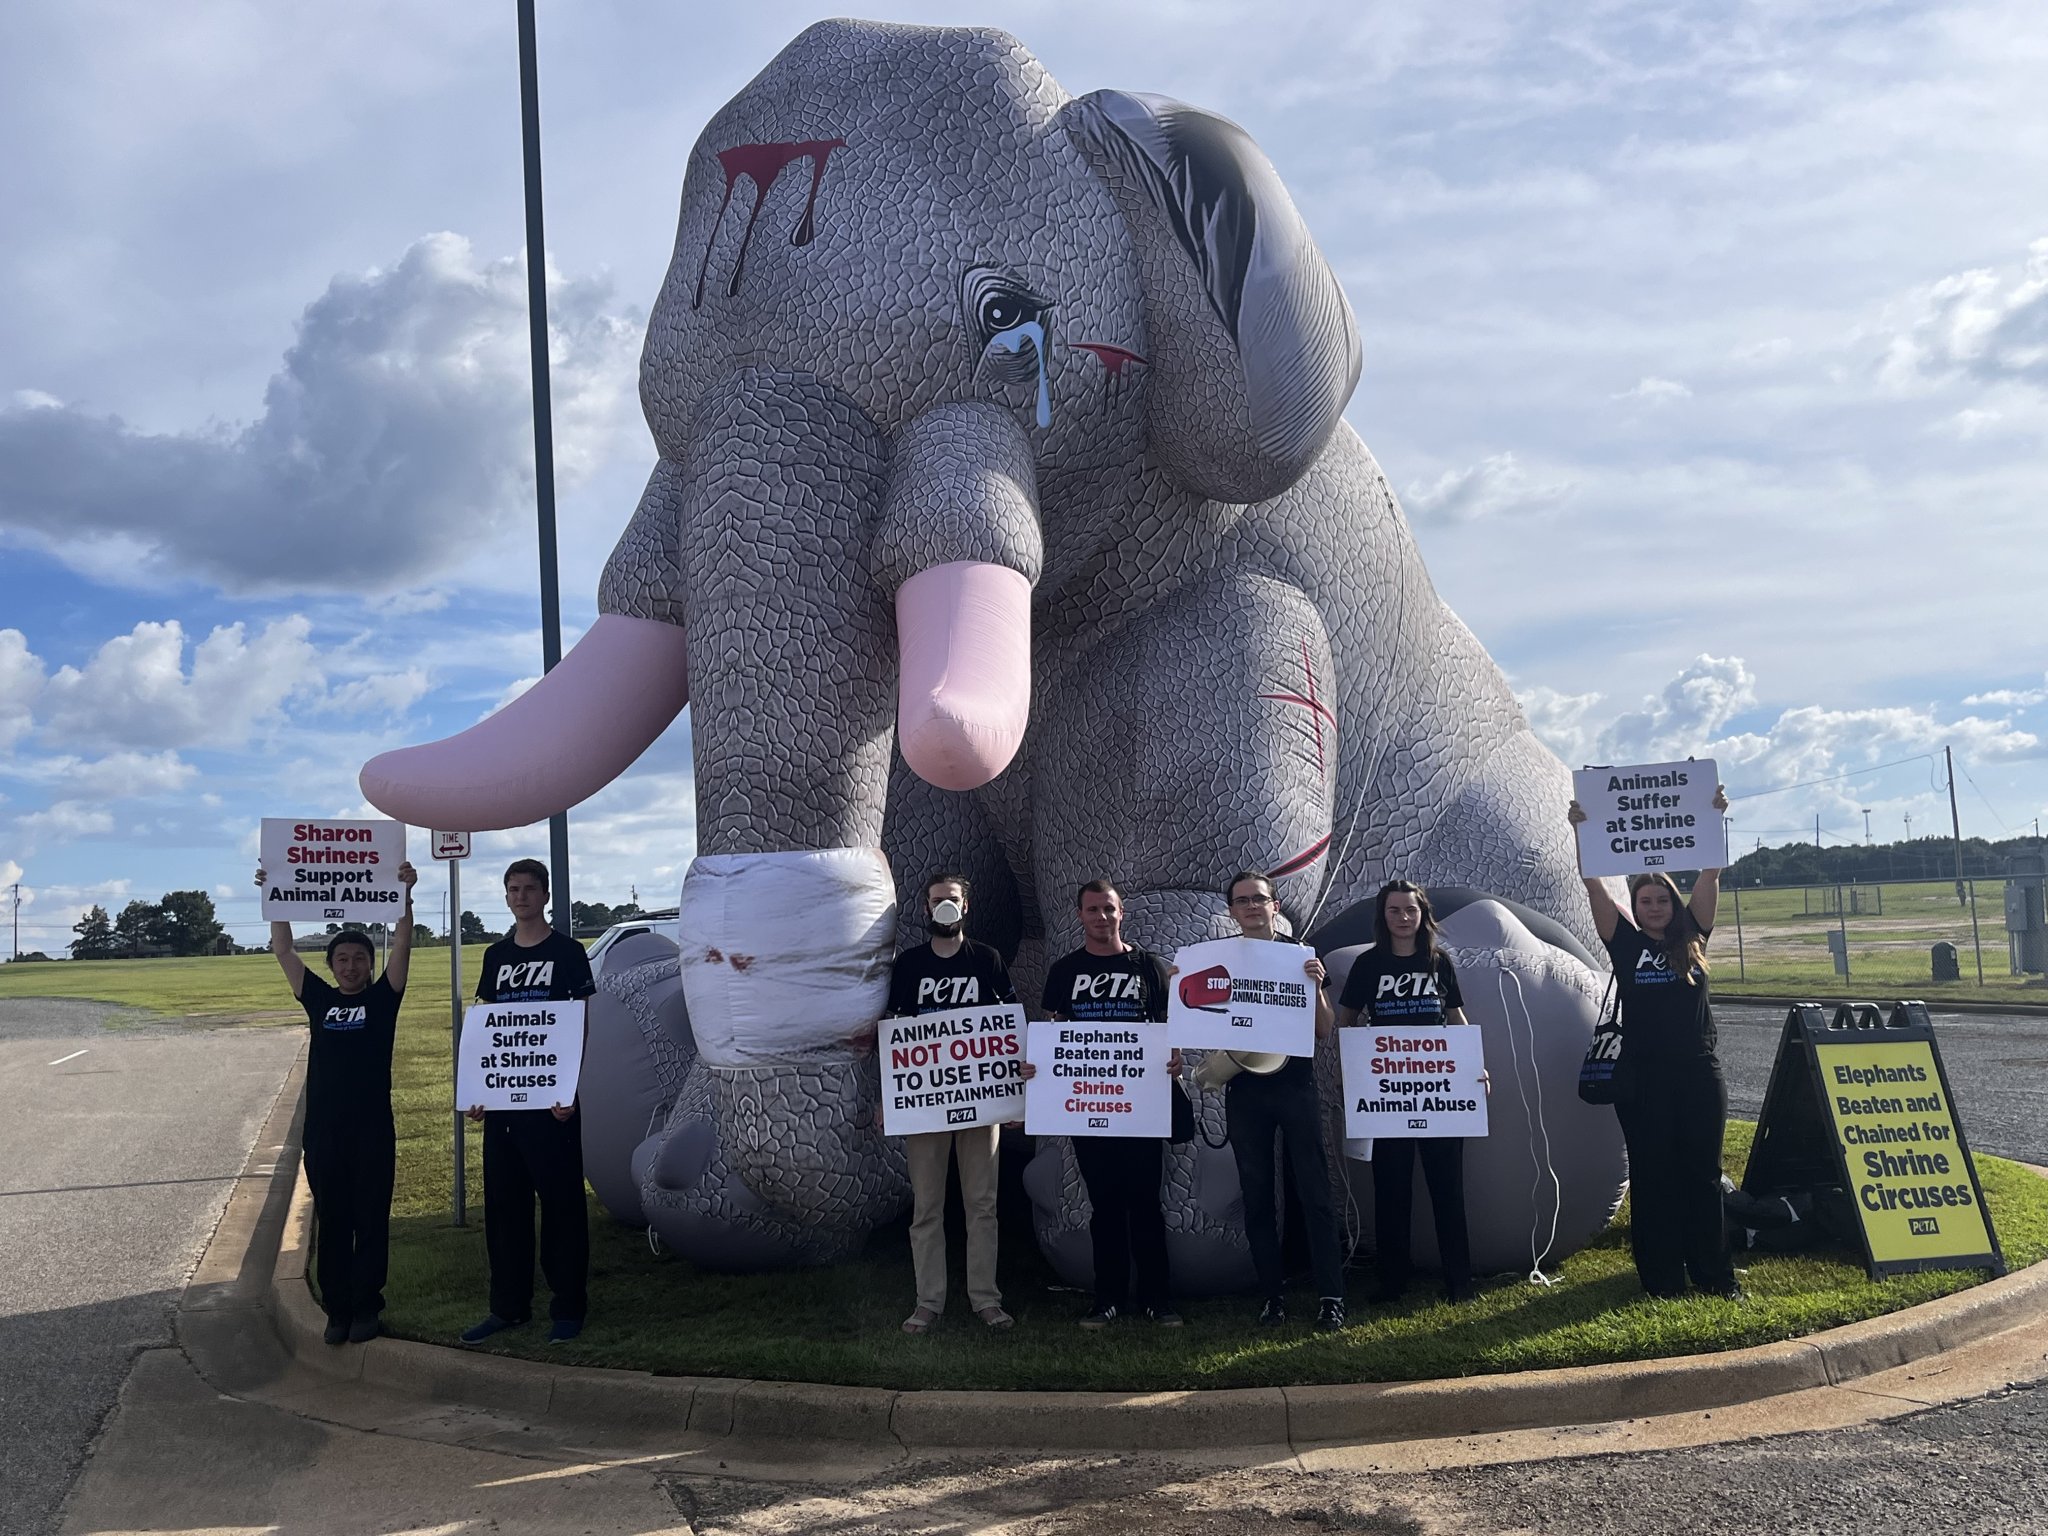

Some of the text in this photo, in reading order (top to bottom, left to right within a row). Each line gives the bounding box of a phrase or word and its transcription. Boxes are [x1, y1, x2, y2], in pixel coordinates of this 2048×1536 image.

[1607, 770, 1688, 792] Animals
[1617, 793, 1680, 813] Suffer
[1606, 813, 1695, 834] at Shrine
[293, 824, 373, 842] Sharon
[442, 833, 459, 843] TIME
[1610, 835, 1695, 854] Circuses
[287, 847, 379, 865] Shriners
[294, 868, 373, 886] Support
[269, 886, 399, 903] Animal Abuse
[1207, 977, 1229, 990] STOP
[1279, 983, 1306, 995] CRUEL
[1232, 991, 1307, 1008] ANIMAL CIRCUSES
[485, 1009, 556, 1028] Animals
[890, 1014, 1016, 1044] ANIMALS ARE
[1059, 1030, 1139, 1045] Elephants
[492, 1031, 548, 1048] Suffer
[1375, 1036, 1447, 1052] Sharon
[481, 1052, 558, 1069] at Shrine
[892, 1035, 1020, 1069] NOT OURS
[1054, 1046, 1144, 1061] Beaten and
[1053, 1064, 1145, 1078] Chained for
[1371, 1057, 1456, 1074] Shriners
[485, 1072, 557, 1089] Circuses
[893, 1060, 1022, 1092] TO USE FOR
[1834, 1064, 1927, 1087] Elephants
[894, 1082, 1024, 1109] ENTERTAINMENT
[1072, 1082, 1124, 1095] Shrine
[1379, 1078, 1451, 1095] Support
[1065, 1099, 1132, 1113] Circuses
[1356, 1096, 1477, 1112] Animal Abuse
[1836, 1092, 1942, 1115] Beaten and
[1844, 1122, 1950, 1145] Chained for
[1864, 1149, 1950, 1178] Shrine
[1860, 1183, 1973, 1211] Circuses
